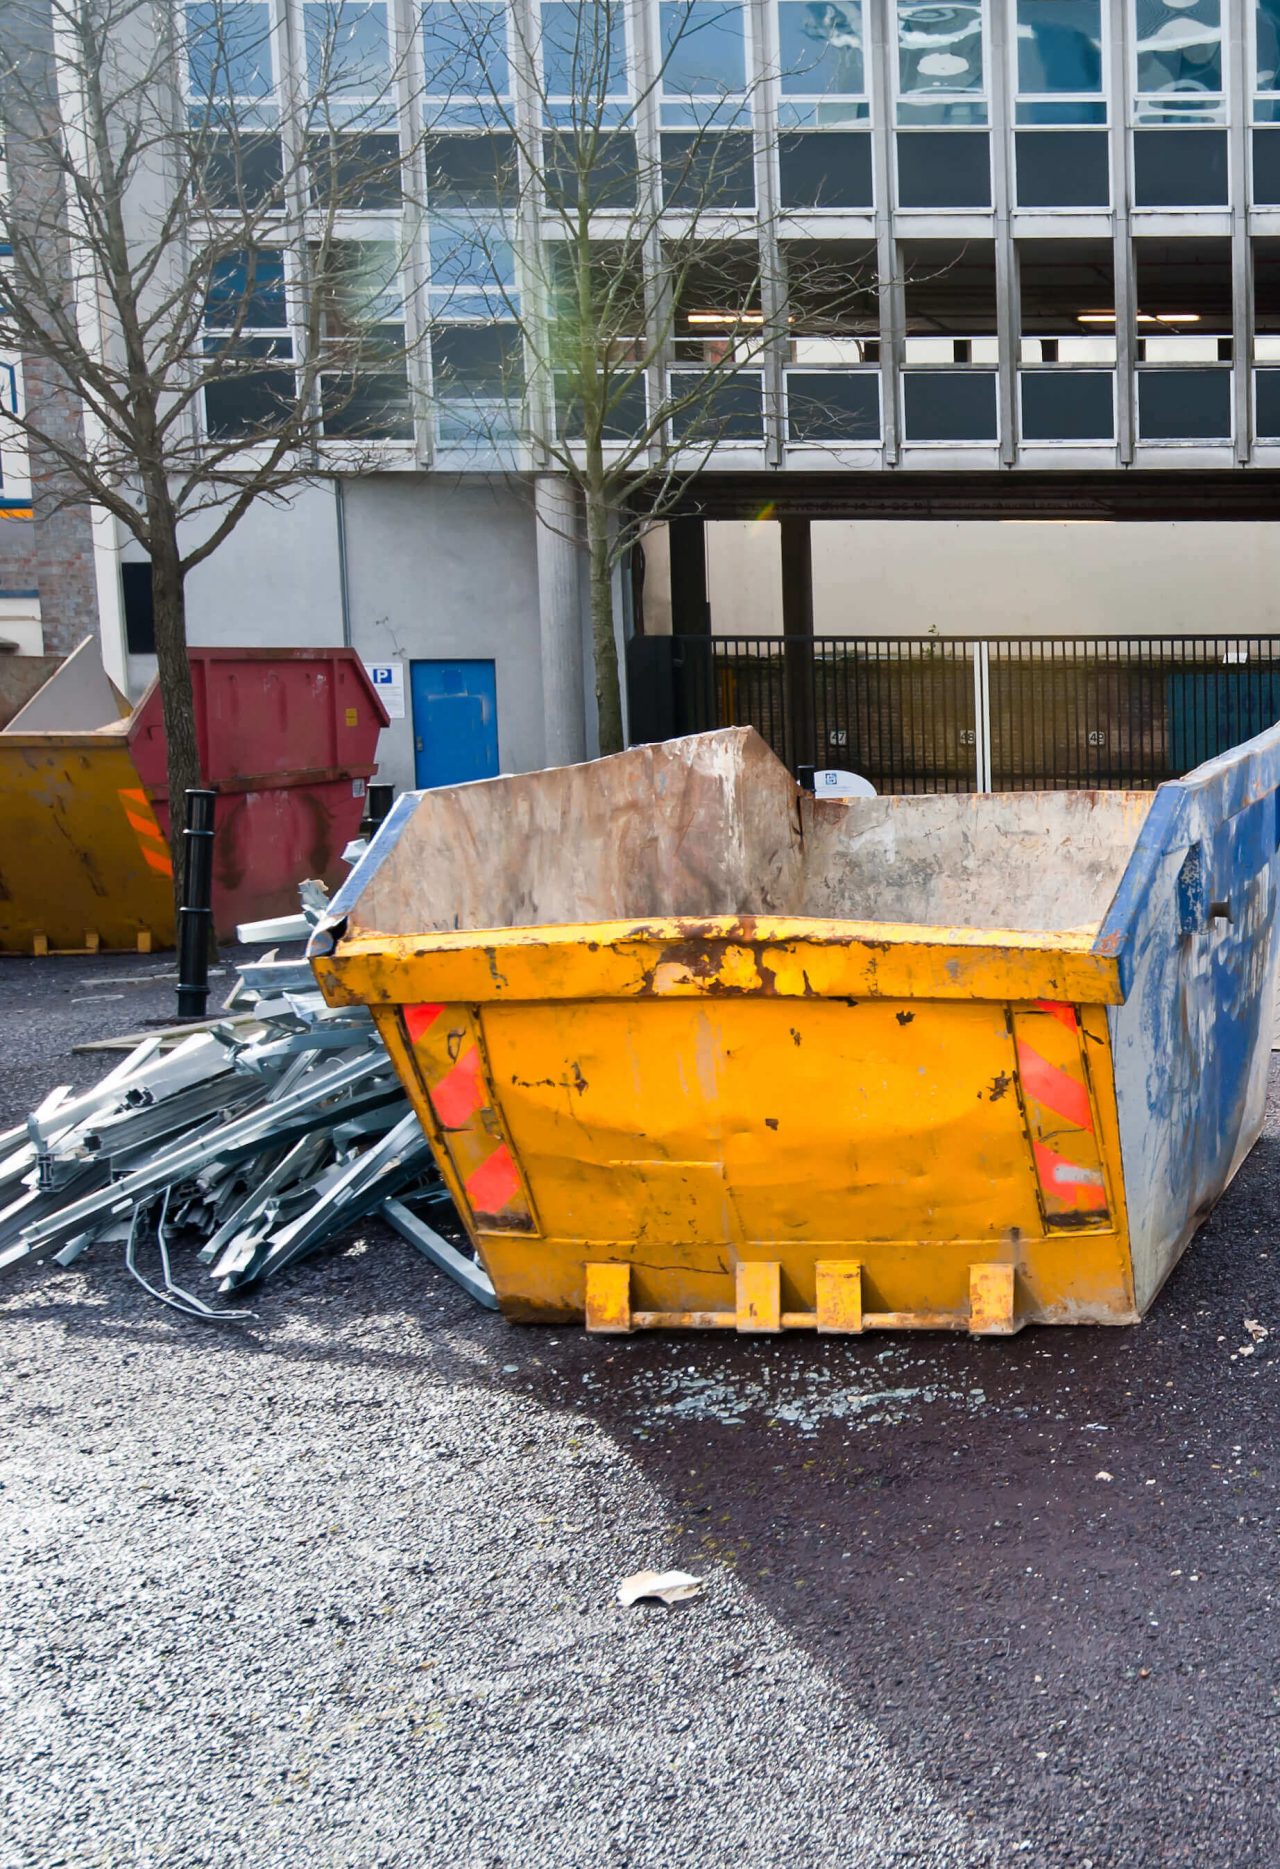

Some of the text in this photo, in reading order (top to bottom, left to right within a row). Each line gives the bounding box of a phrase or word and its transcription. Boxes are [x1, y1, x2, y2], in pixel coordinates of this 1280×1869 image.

[377, 669, 389, 683] P
[832, 732, 845, 742] 47
[961, 732, 975, 742] 48
[1090, 733, 1104, 742] 49
